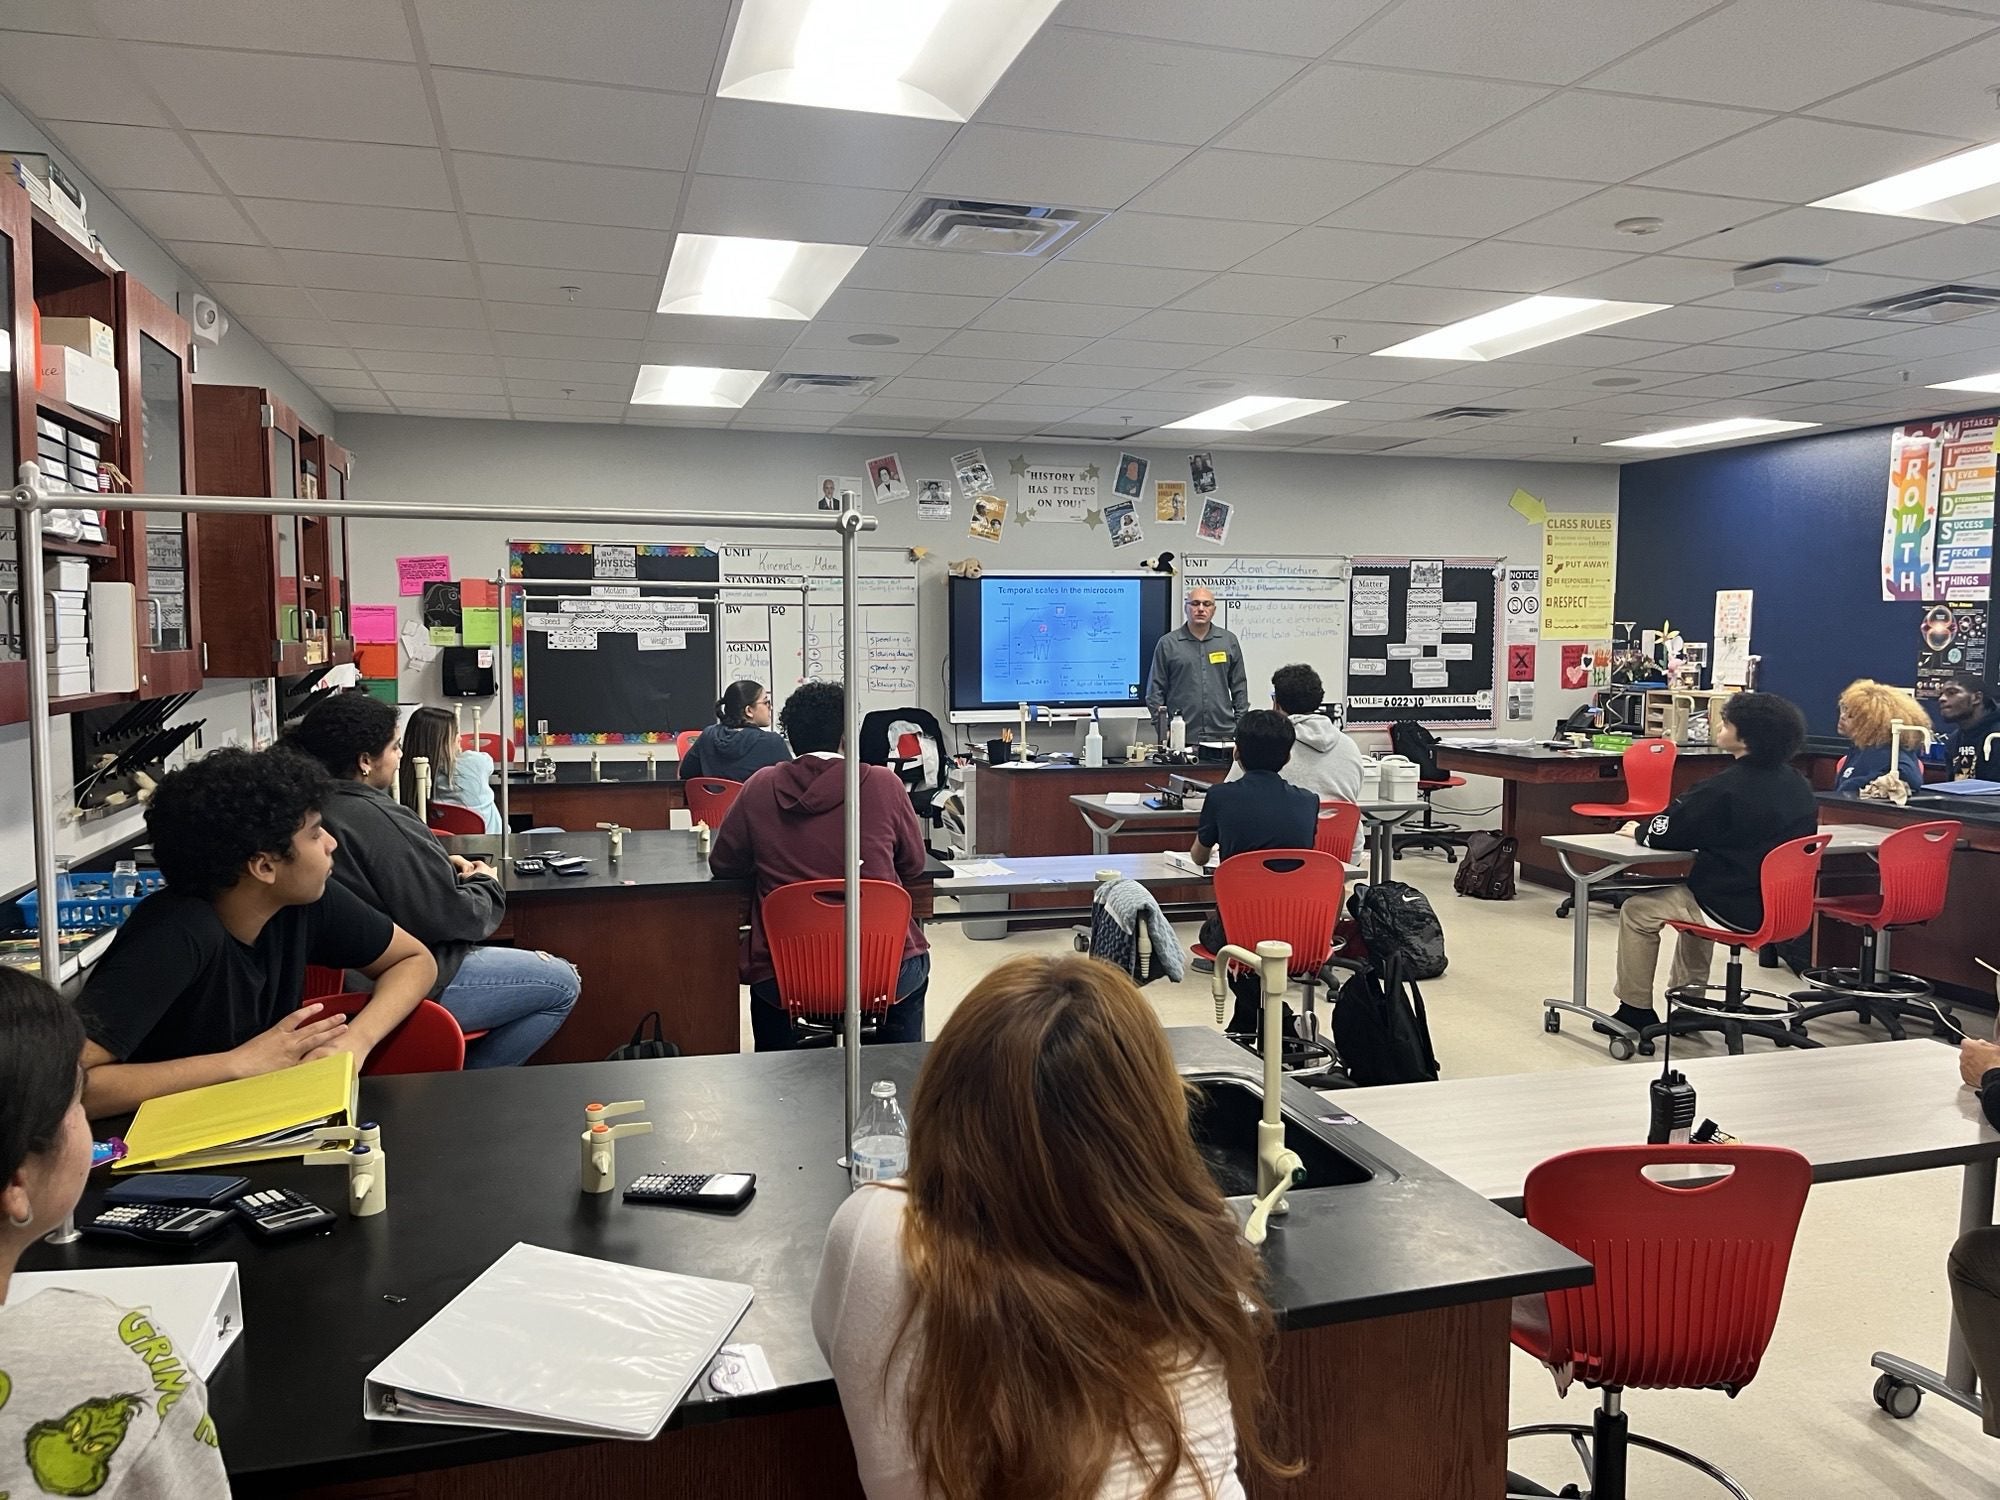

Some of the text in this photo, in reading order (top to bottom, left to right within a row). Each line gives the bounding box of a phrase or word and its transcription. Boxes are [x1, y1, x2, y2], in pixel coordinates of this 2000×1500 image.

[1944, 470, 1979, 490] NEVER
[1028, 485, 1096, 496] HAS ITS EYES
[1037, 499, 1053, 508] ON
[1547, 519, 1612, 530] CLASS RULES
[1941, 520, 1984, 540] SUCCESS
[724, 548, 752, 557] UNIT
[593, 558, 636, 568] PHYSICS
[1185, 559, 1209, 567] UNIT
[1938, 548, 1980, 568] EFFORT
[1223, 559, 1264, 575] Atom
[1565, 560, 1609, 569] PUT AWAY!
[724, 575, 786, 585] STANDARDS
[1509, 570, 1539, 580] NOTICE
[1185, 578, 1237, 586] STANDARDS
[1358, 580, 1383, 588] Matter
[1937, 576, 1979, 595] THINGS
[603, 587, 628, 595] Motion
[998, 586, 1034, 596] Temporal
[1035, 587, 1059, 595] scales
[1069, 586, 1082, 595] the
[1083, 586, 1125, 595] microcosm
[614, 602, 642, 613] Velocity
[1228, 601, 1242, 609] EQ
[1553, 596, 1588, 609] RESPECT
[725, 605, 743, 614] BW
[770, 605, 786, 615] EQ
[540, 617, 561, 627] Speed
[1360, 621, 1381, 631] Density
[1545, 619, 1553, 629] 5
[558, 634, 589, 646] Gravity
[651, 637, 674, 648] Weight
[726, 643, 768, 652] AGENDA
[1431, 695, 1477, 704] PARTICLES
[118, 1311, 191, 1418] GRINC
